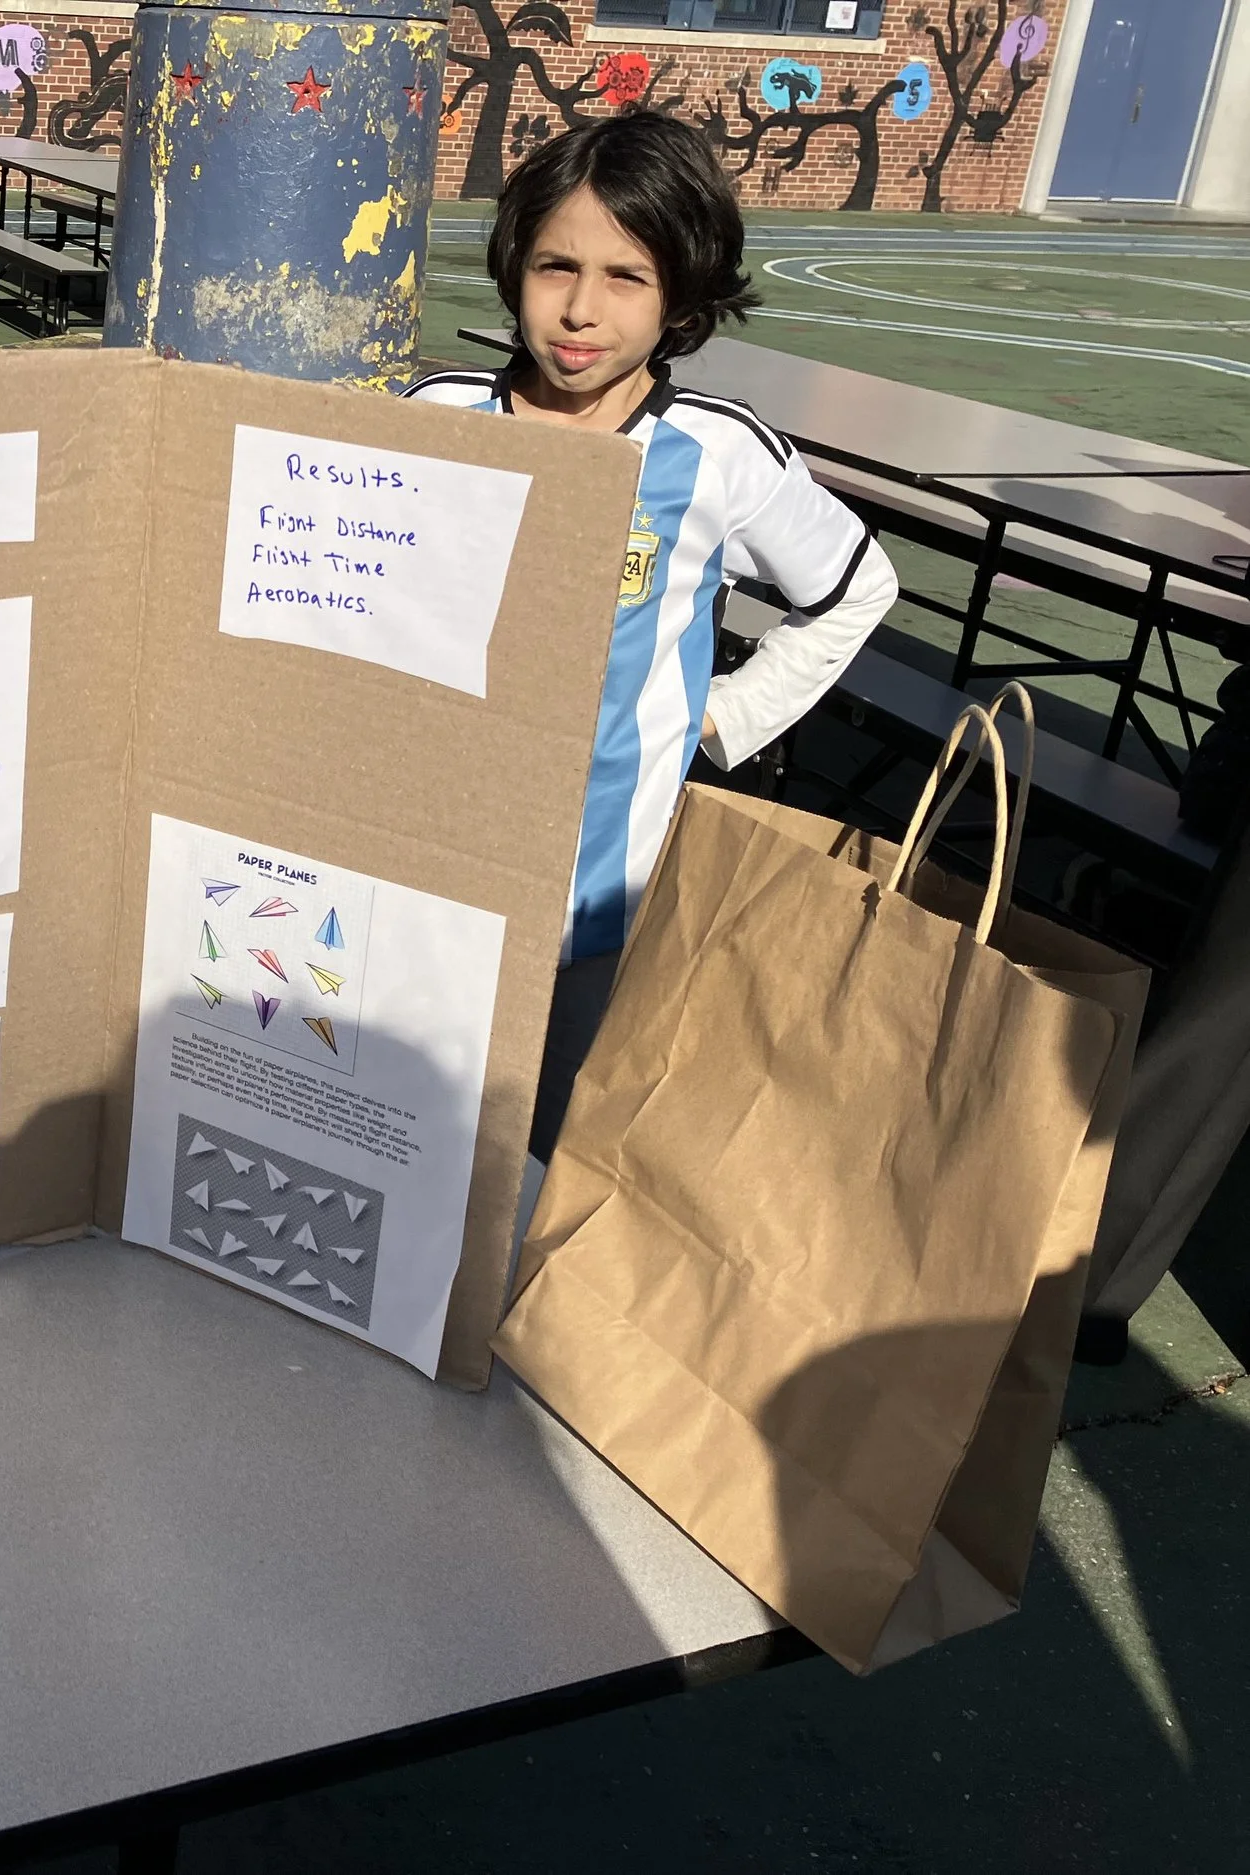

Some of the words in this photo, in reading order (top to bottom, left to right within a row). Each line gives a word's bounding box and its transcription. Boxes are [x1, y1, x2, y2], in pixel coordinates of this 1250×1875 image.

[337, 517, 416, 546] Distance
[253, 544, 312, 567] Flight
[324, 552, 385, 576] Time
[238, 853, 273, 871] PAPER
[277, 864, 317, 886] PLANES
[173, 1036, 198, 1049] science
[199, 1045, 222, 1058] behind
[223, 1054, 238, 1064] their
[260, 1067, 269, 1077] By
[271, 1072, 294, 1086] testing
[296, 1082, 324, 1096] different
[326, 1093, 347, 1104] paper
[373, 1110, 385, 1119] the
[192, 1033, 218, 1049] Building
[220, 1044, 228, 1052] on
[230, 1048, 241, 1056] the
[243, 1052, 254, 1061] fun
[263, 1061, 283, 1071] paper
[321, 1081, 334, 1091] this
[335, 1087, 360, 1100] project
[387, 1106, 402, 1116] into
[404, 1112, 416, 1121] the
